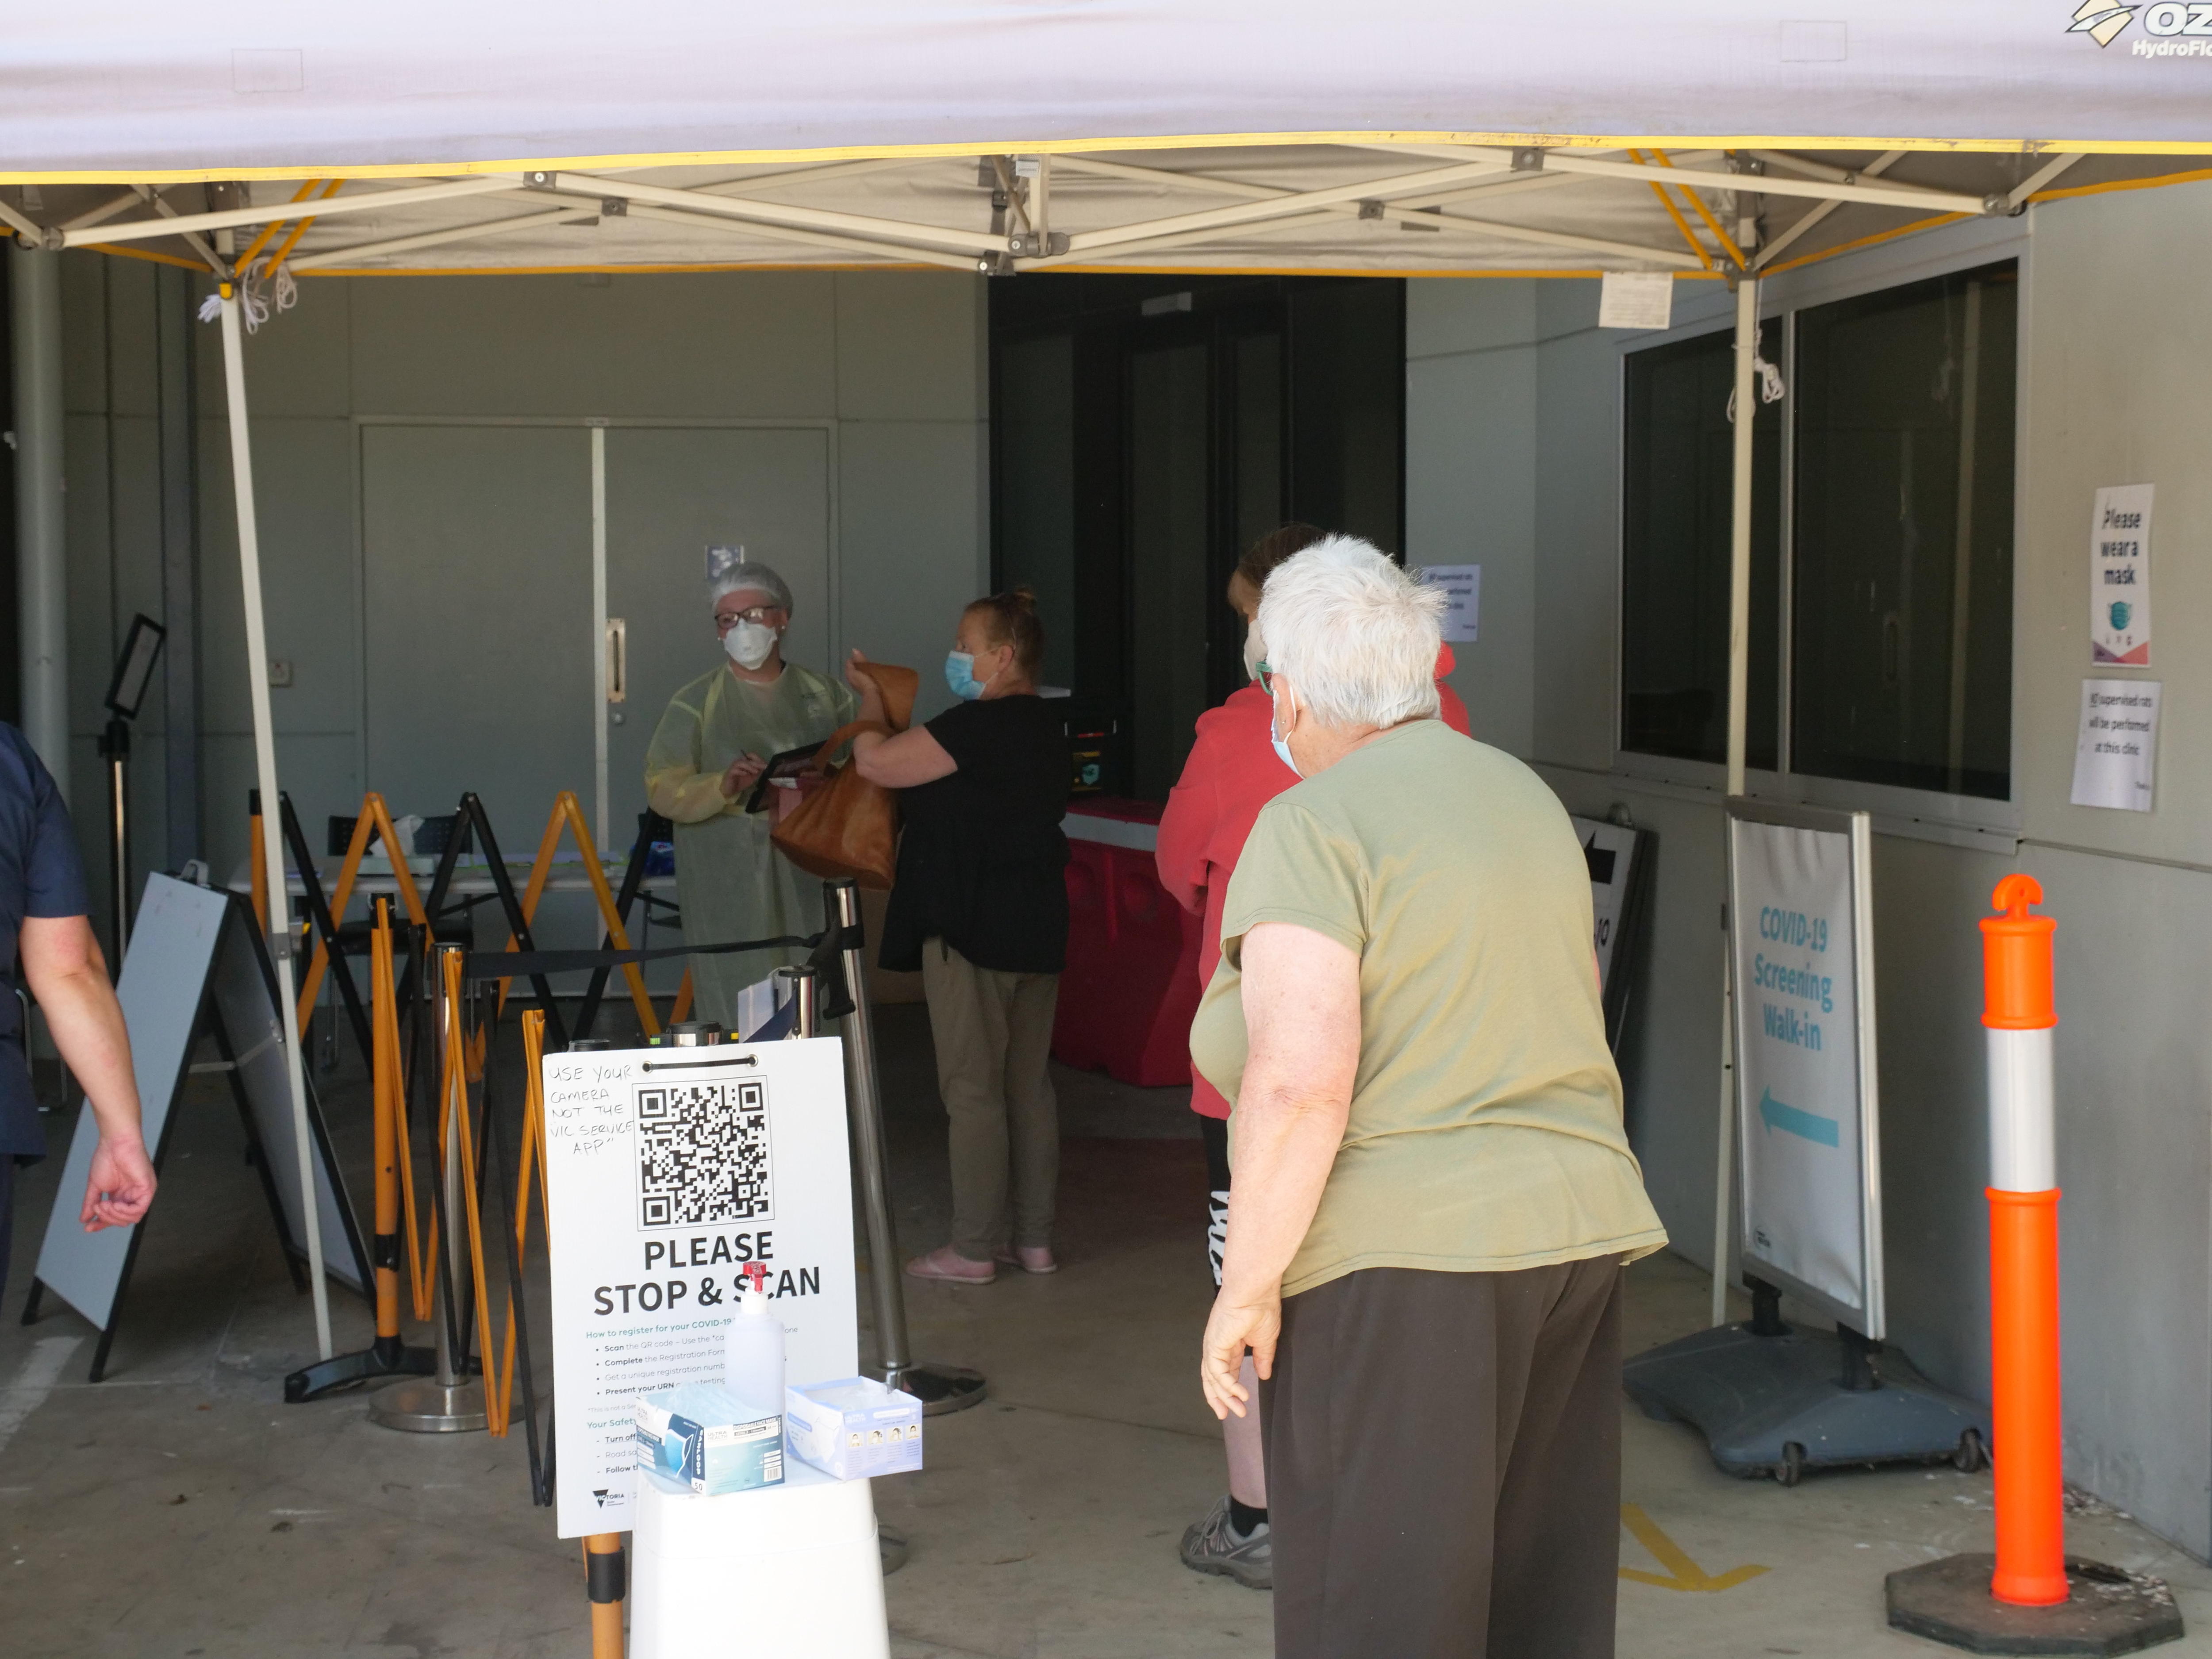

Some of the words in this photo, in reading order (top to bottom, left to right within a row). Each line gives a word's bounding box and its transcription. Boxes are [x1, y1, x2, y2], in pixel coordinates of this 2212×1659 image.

[2102, 508, 2142, 530] Please
[2101, 541, 2128, 557] wear
[2131, 540, 2139, 556] a
[2104, 564, 2136, 584] mask
[1760, 906, 1828, 952] COVID-19
[1754, 952, 1833, 1014] Screening
[1763, 1002, 1821, 1051] Walk-in
[549, 1066, 584, 1081] USE
[592, 1064, 633, 1083] YOUR
[550, 1088, 610, 1103] CAMERA
[552, 1106, 585, 1118] NOT
[594, 1104, 623, 1116] THE
[645, 1231, 774, 1270] PLEASE
[594, 1279, 687, 1316] STOP
[698, 1277, 723, 1306] &
[619, 1326, 653, 1337] register
[656, 1324, 668, 1333] for
[670, 1323, 690, 1333] your
[692, 1318, 732, 1329] COVID-19
[605, 1358, 643, 1367] Complete
[660, 1350, 706, 1362] Registration
[628, 1370, 655, 1380] unique
[657, 1365, 702, 1377] registration
[703, 1362, 726, 1371] numb
[605, 1387, 636, 1396] Present
[637, 1384, 656, 1394] your
[587, 1421, 607, 1429] Your
[606, 1449, 626, 1459] Road
[694, 1482, 703, 1491] 50
